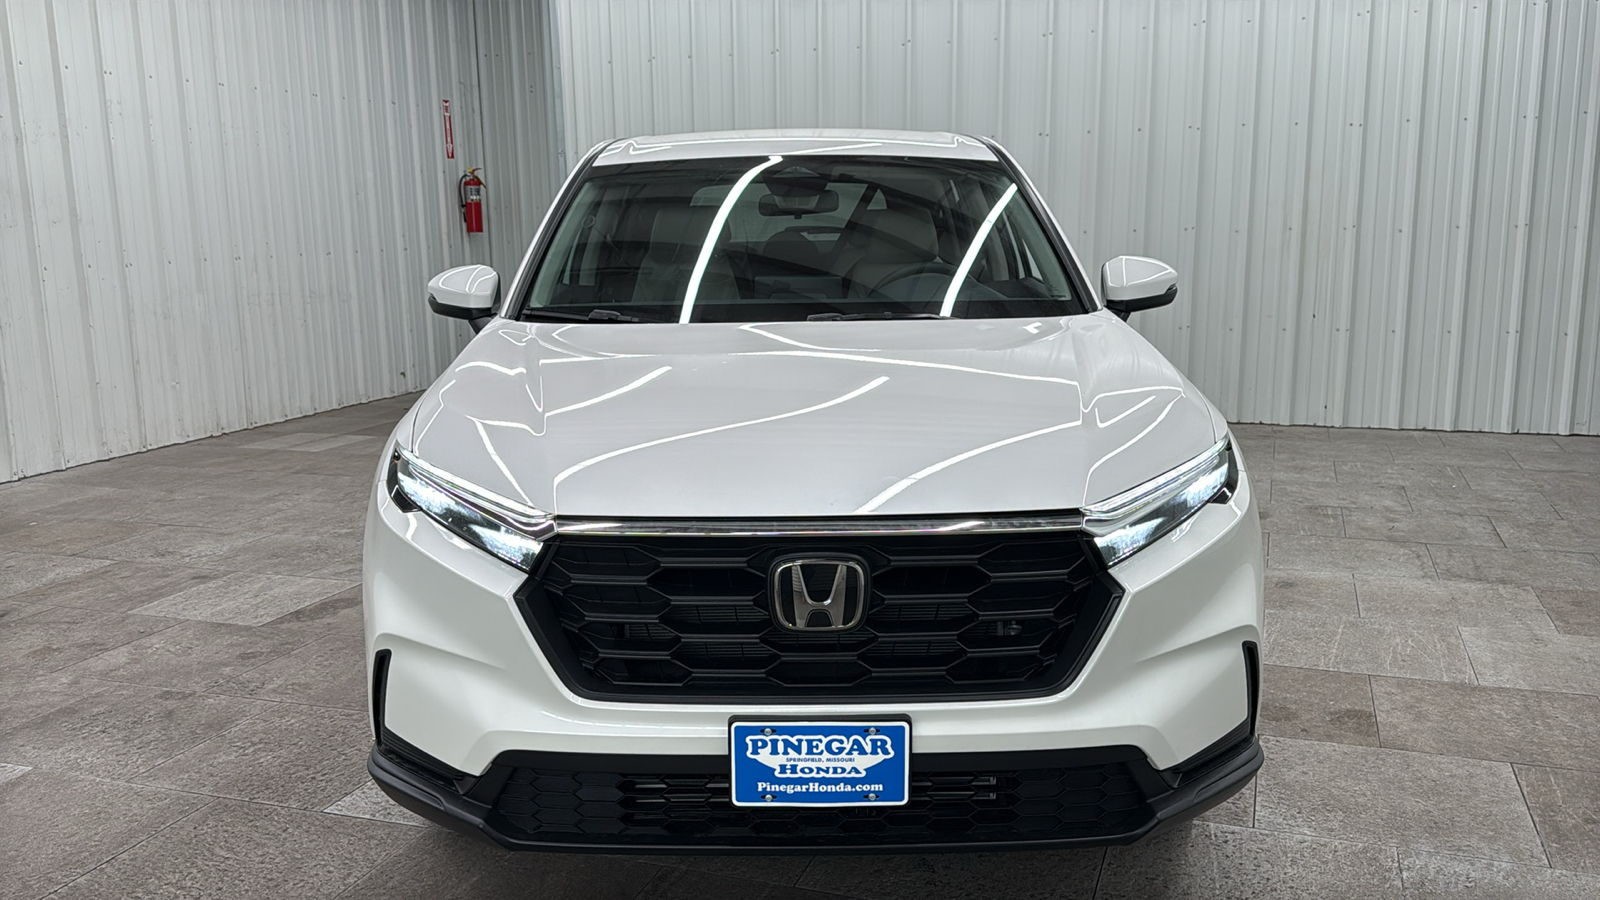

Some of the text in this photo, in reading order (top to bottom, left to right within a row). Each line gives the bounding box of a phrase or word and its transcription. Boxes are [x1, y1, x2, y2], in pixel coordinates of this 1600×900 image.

[749, 738, 893, 756] PINEGAR
[777, 764, 863, 775] HONDA
[757, 782, 884, 794] PinegarHonda.com
